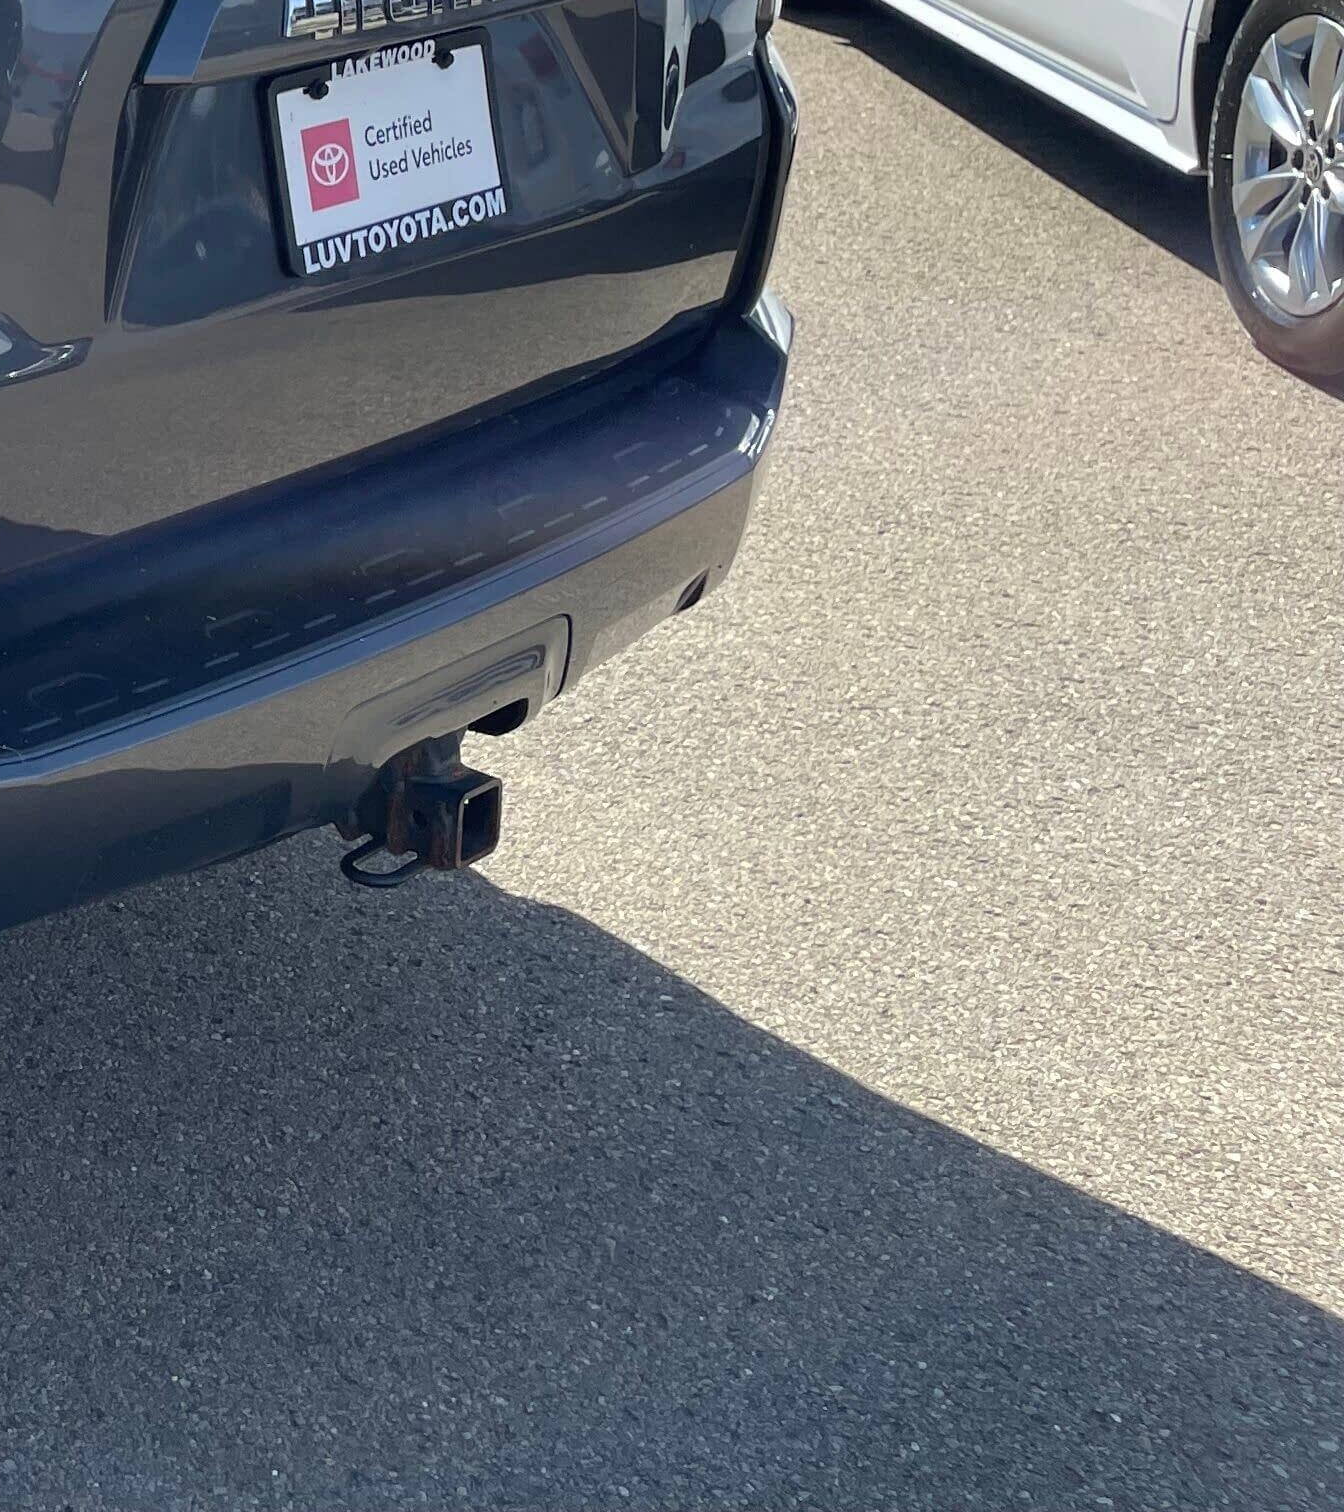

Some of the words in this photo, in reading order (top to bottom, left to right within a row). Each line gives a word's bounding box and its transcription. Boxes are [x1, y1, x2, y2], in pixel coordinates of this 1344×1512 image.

[330, 39, 436, 82] LAKEWOOD
[364, 111, 433, 147] Certified
[369, 151, 409, 181] Used
[413, 137, 473, 172] Vehicles
[303, 189, 506, 275] LUVTOYOTA.COM
